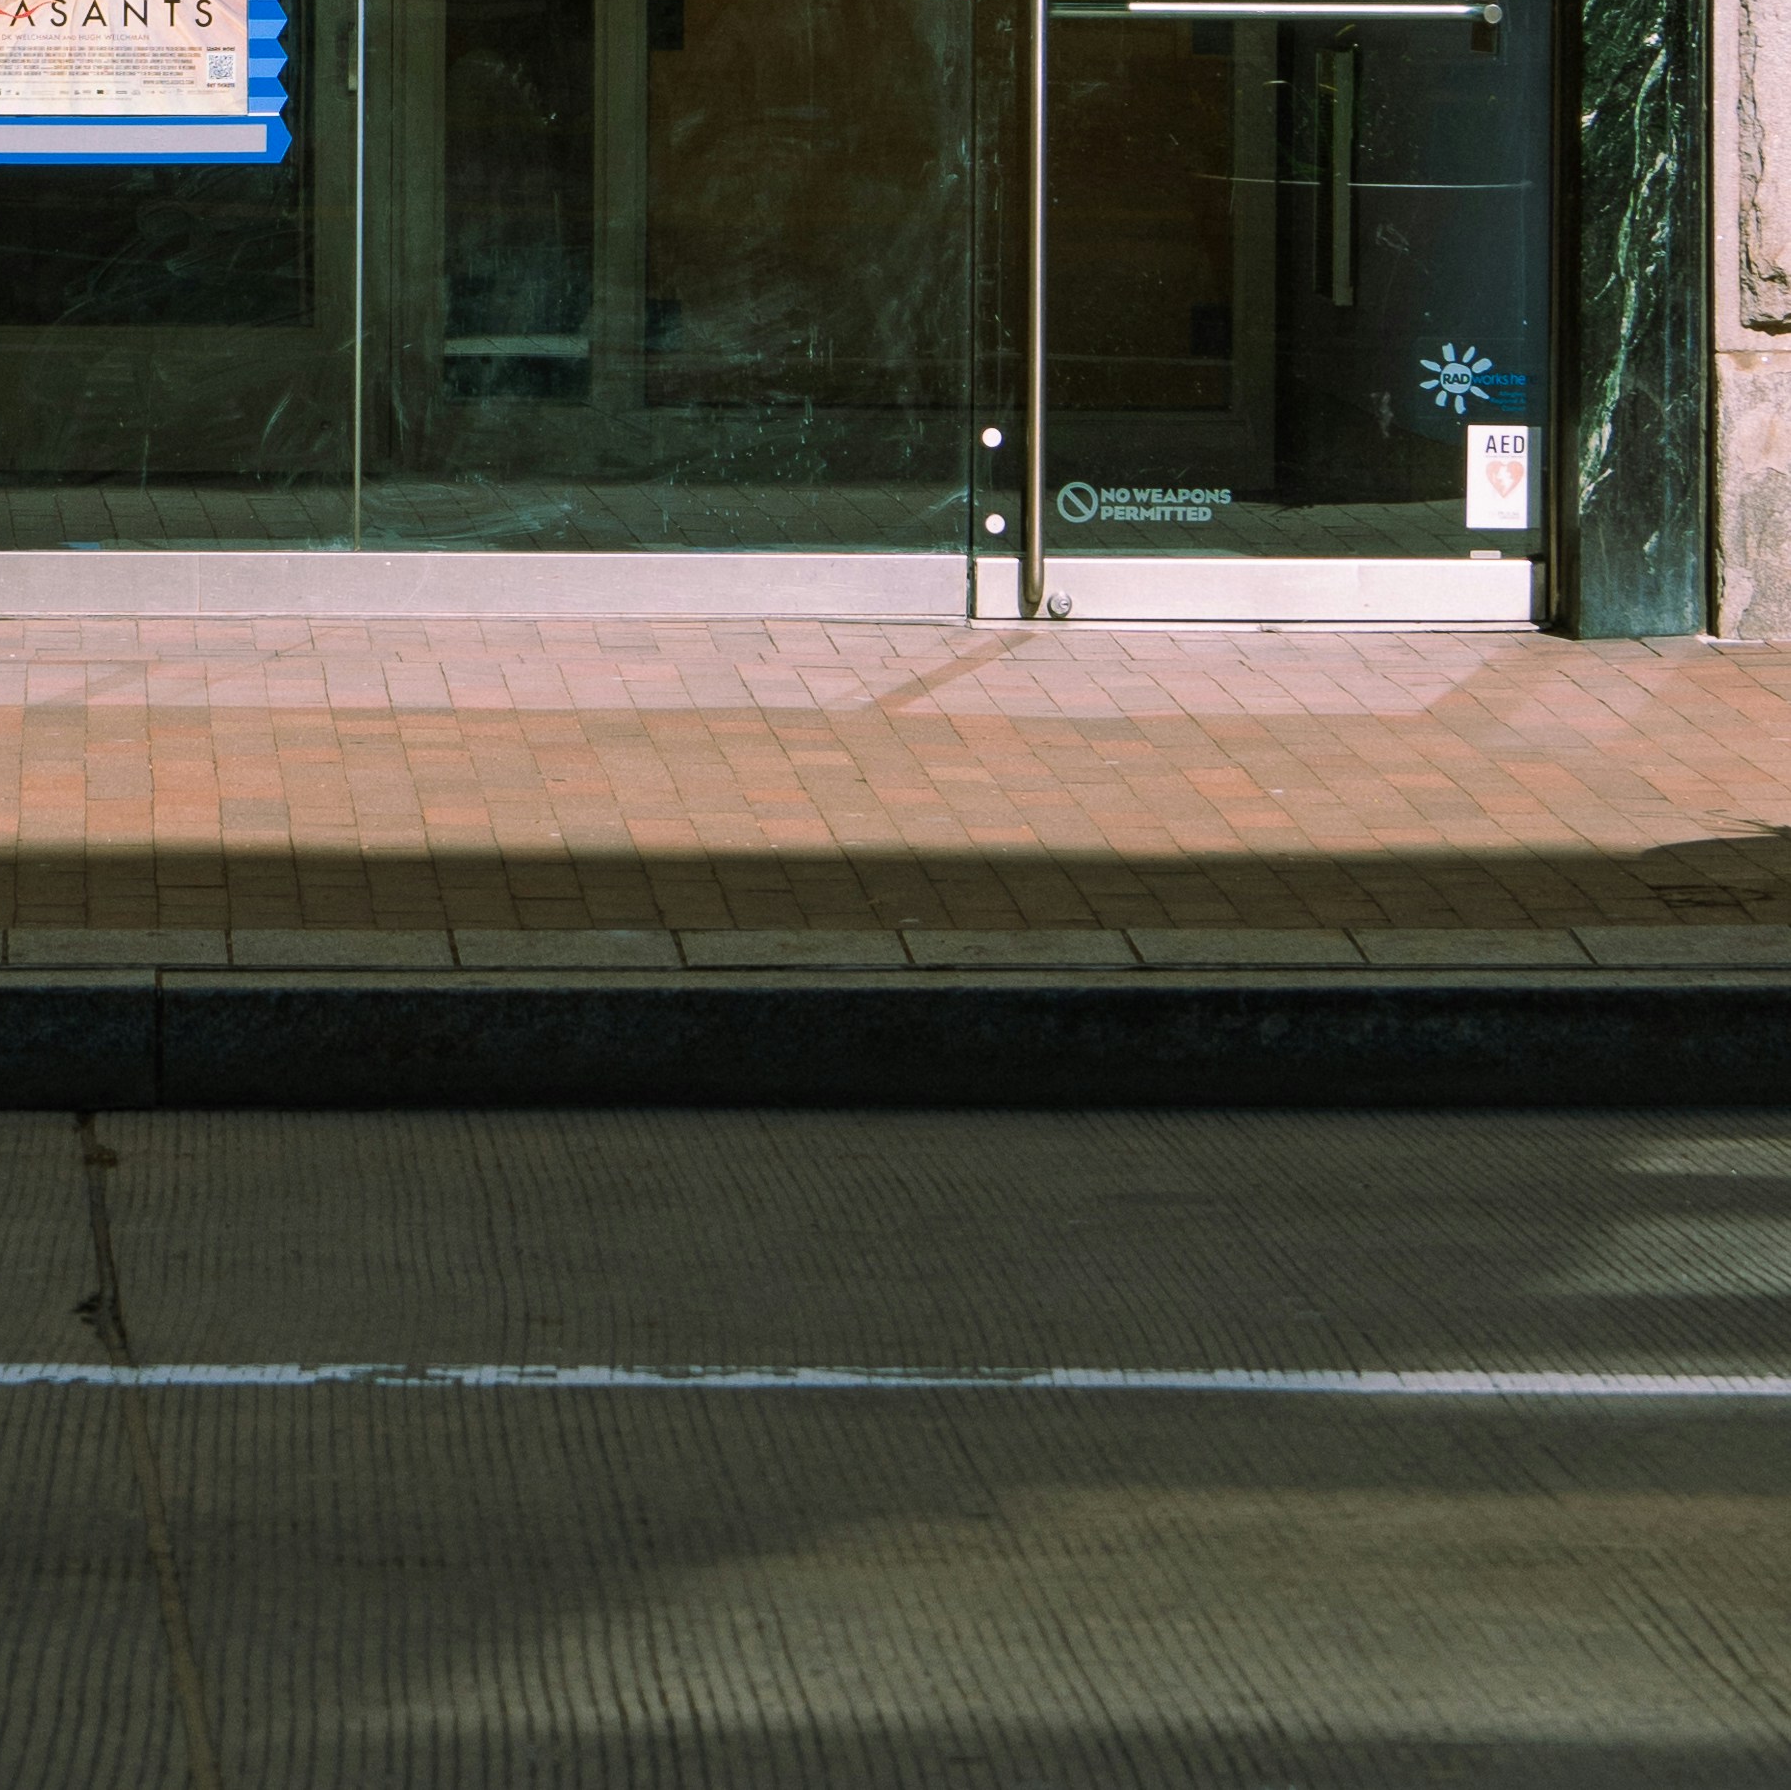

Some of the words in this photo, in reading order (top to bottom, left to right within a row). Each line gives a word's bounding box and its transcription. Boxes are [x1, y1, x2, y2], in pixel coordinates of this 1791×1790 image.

[1442, 373, 1470, 385] RAD
[1472, 373, 1508, 386] works
[1485, 435, 1525, 454] AED
[1101, 488, 1130, 504] NO
[1132, 488, 1232, 504] WEAPONS
[1100, 506, 1212, 522] PERMITTED
